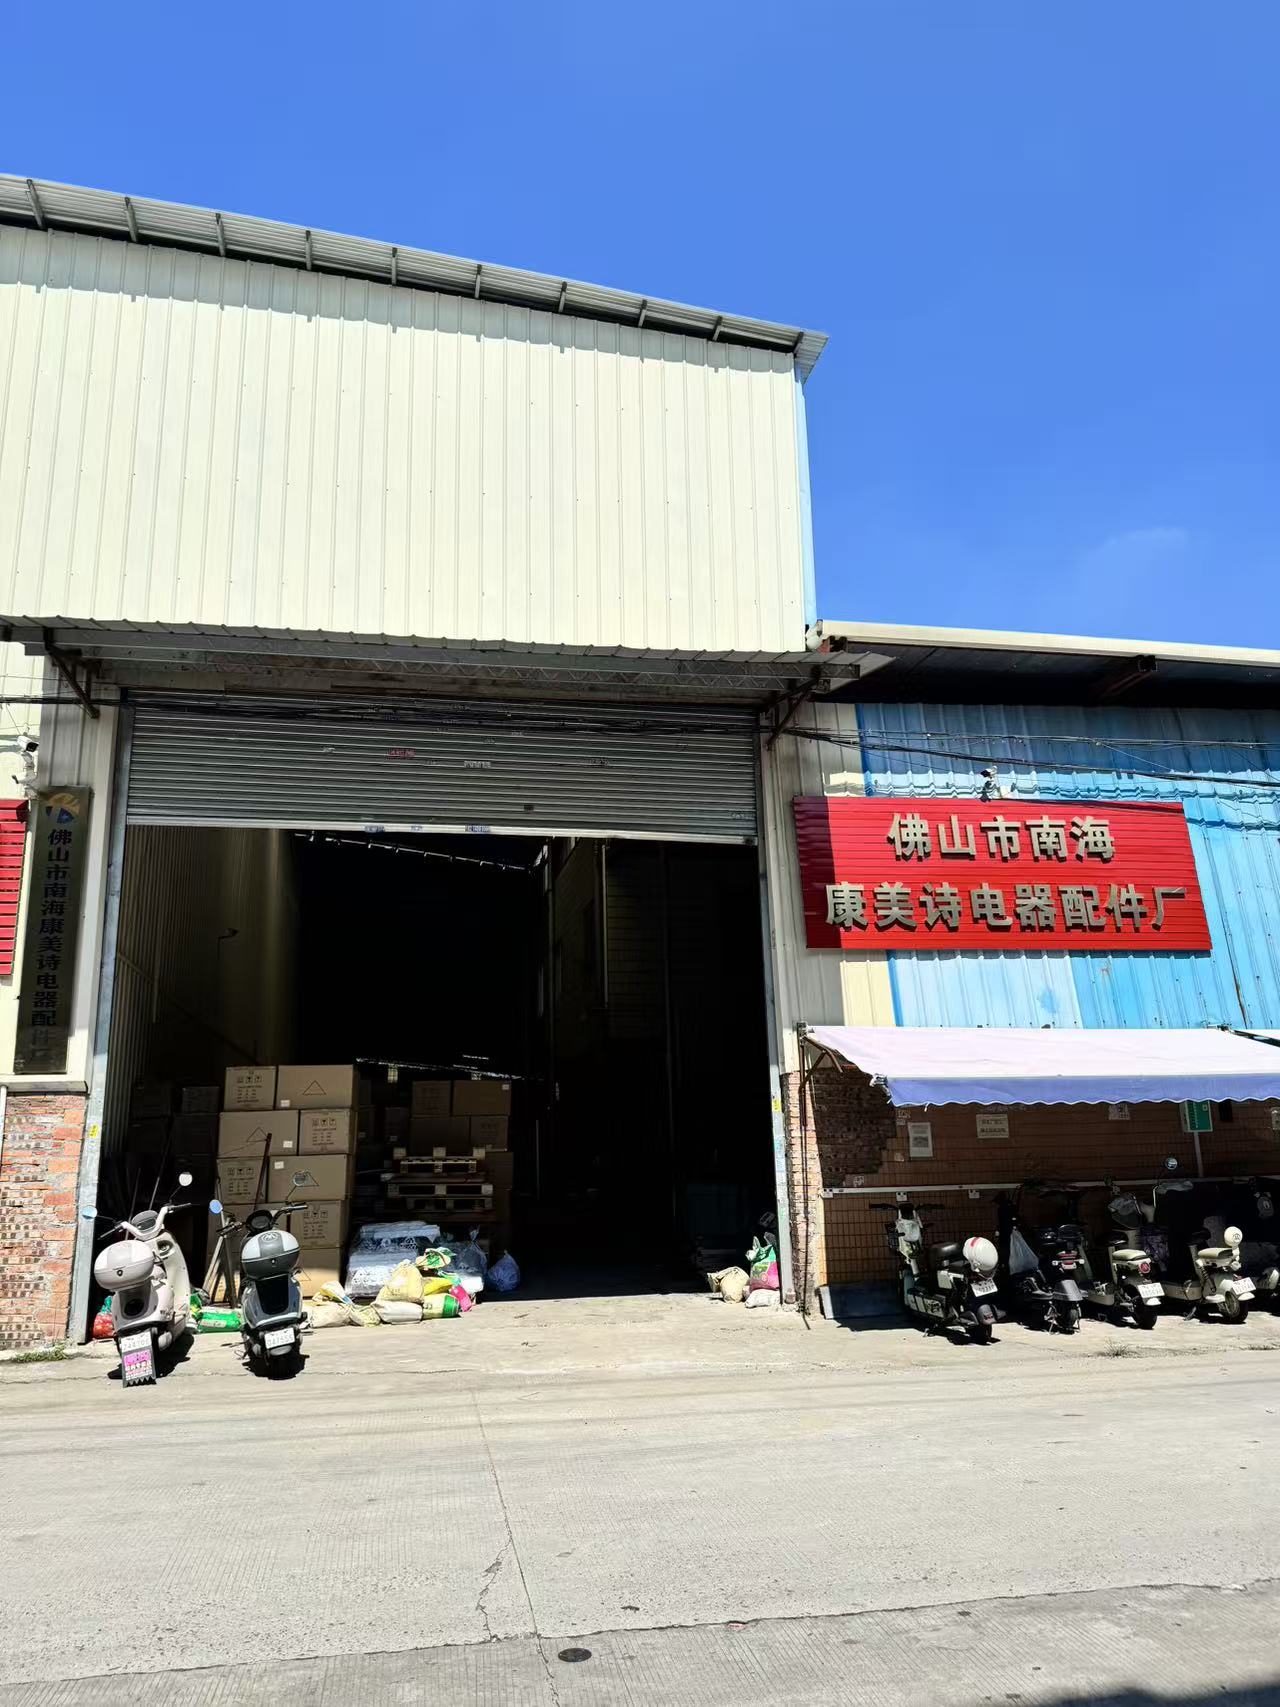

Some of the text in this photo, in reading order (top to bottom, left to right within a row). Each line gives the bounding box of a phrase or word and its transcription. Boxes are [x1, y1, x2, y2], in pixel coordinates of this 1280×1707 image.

[888, 812, 1116, 861] 佛山市南海
[825, 881, 1187, 931] 康美诗电器配件厂
[31, 828, 73, 1058] 佛山市南海康美诗电器配
